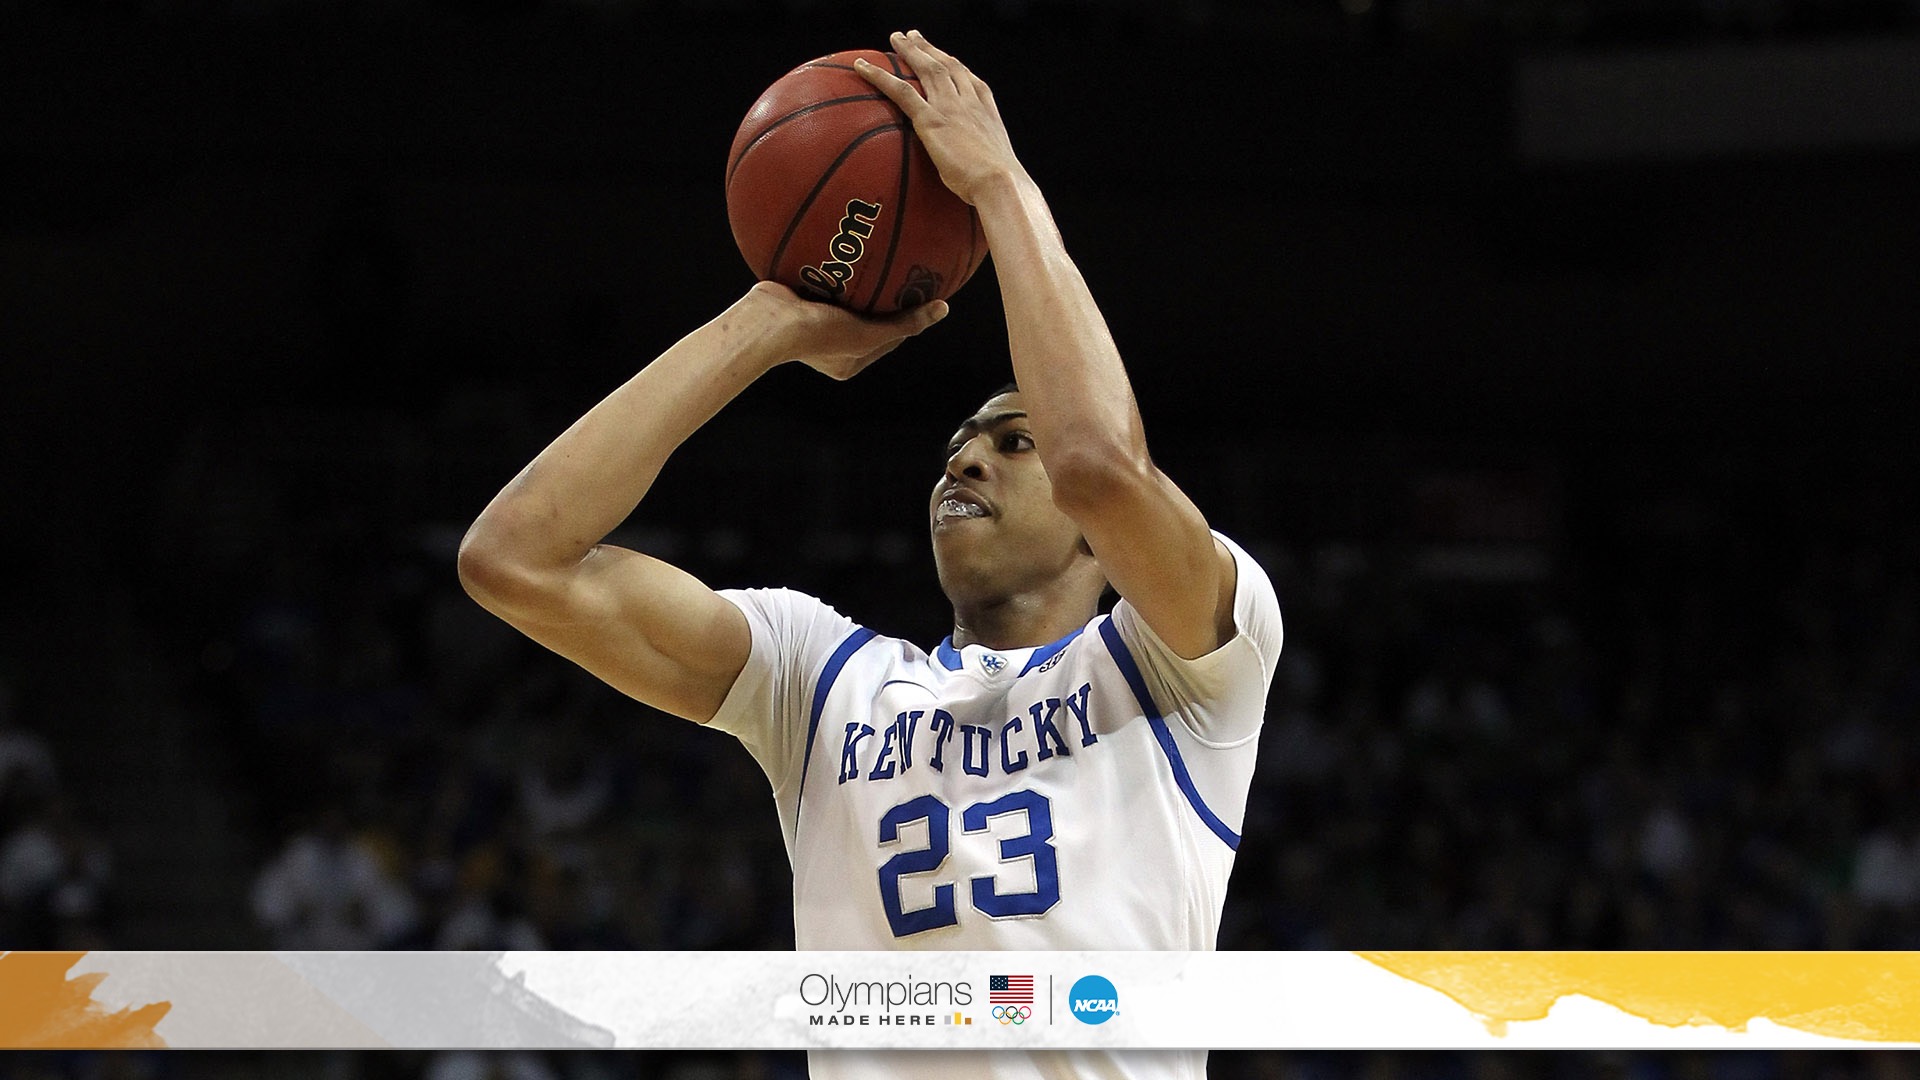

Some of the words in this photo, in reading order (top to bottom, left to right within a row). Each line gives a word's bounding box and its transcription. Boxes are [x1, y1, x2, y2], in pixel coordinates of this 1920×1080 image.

[800, 198, 882, 300] lson
[838, 682, 1099, 785] KENTUCKY
[877, 789, 1062, 938] 23
